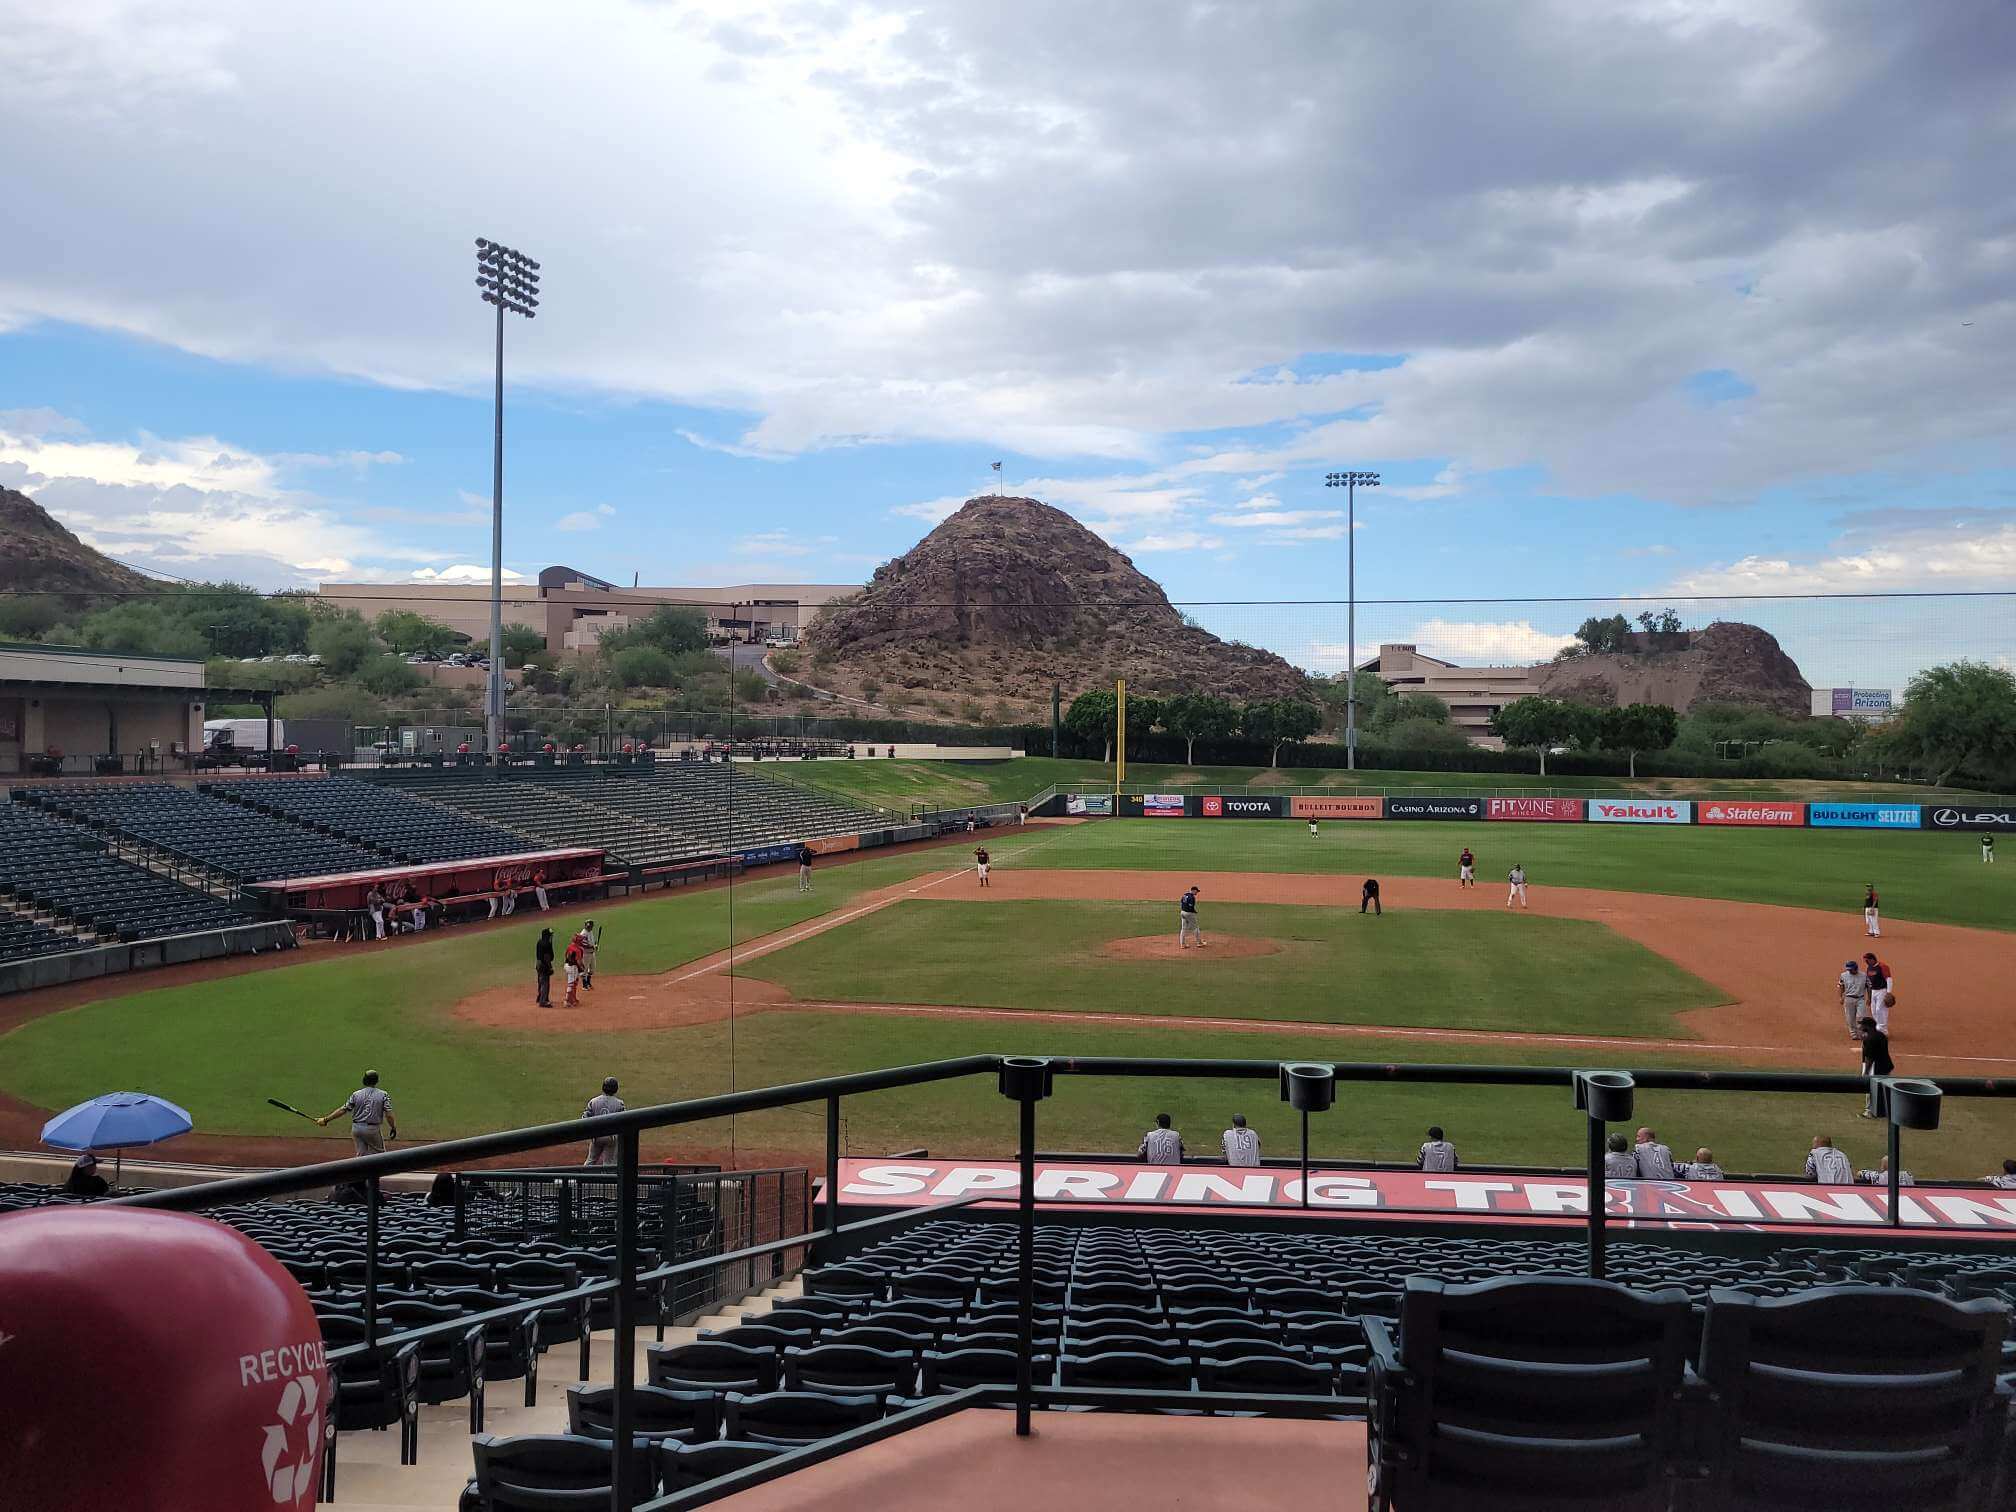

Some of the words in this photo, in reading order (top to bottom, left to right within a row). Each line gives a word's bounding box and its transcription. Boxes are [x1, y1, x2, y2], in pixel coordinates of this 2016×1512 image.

[1853, 691, 1889, 700] Protecting
[1227, 801, 1271, 812] TOYOTA
[1299, 803, 1334, 812] BULLEIT
[1335, 803, 1376, 812] BOURBON
[1491, 800, 1554, 815] FITVINE
[1598, 805, 1679, 819] Yakult
[1814, 811, 1838, 820] BUD
[1840, 811, 1877, 821] LIGHT
[1878, 810, 1918, 824] SELTZER
[1236, 1134, 1253, 1150] 19
[1438, 1152, 1446, 1170] 7
[1653, 1151, 1665, 1169] 4
[841, 1166, 1379, 1207] SPRING
[239, 1341, 326, 1387] RECYCLE
